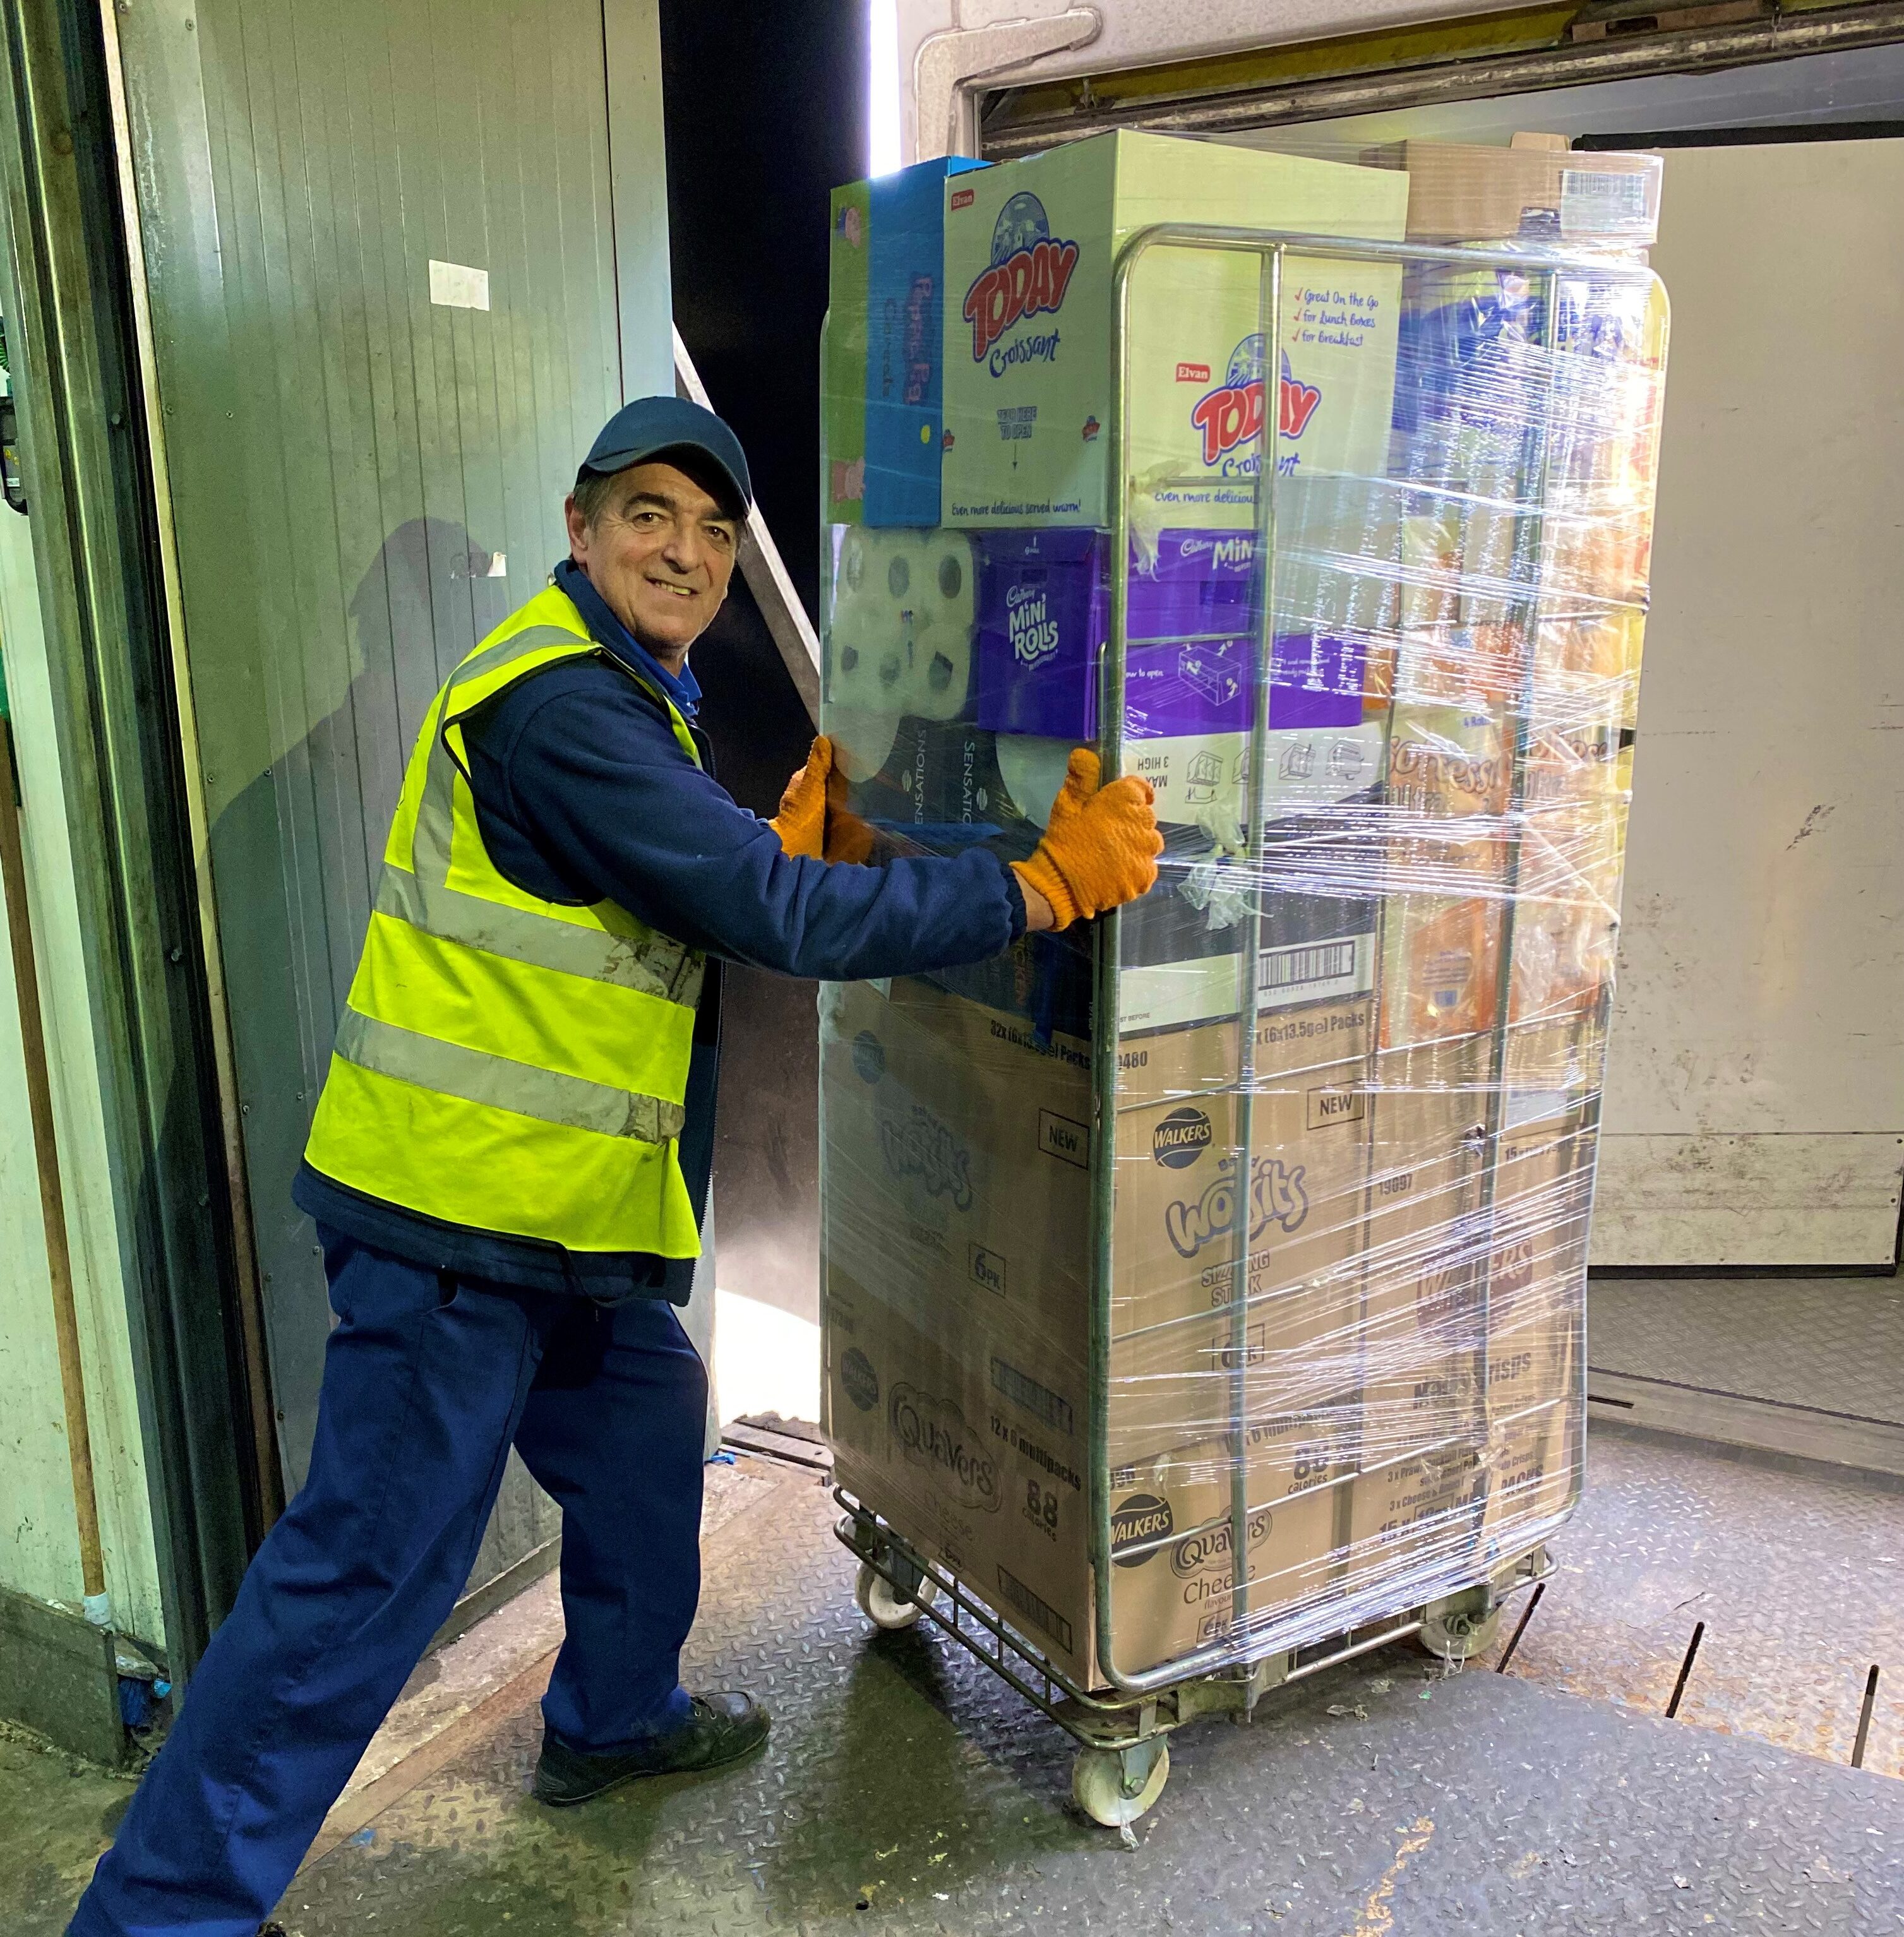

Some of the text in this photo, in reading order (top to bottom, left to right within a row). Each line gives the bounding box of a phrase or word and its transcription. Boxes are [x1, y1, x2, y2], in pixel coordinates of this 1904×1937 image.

[964, 239, 1079, 361] TODAY
[1305, 289, 1379, 311] Great On the Go
[989, 328, 1061, 378] Croissant
[1178, 366, 1209, 380] Elvan
[991, 499, 1023, 515] delicious
[1183, 492, 1210, 503] more
[1214, 488, 1254, 503] deliciou
[1014, 620, 1059, 661] ROLLS
[915, 729, 926, 825] ENSATIONS
[1137, 756, 1170, 771] 3 HIGH
[962, 741, 975, 824] SENSATIO
[1128, 1013, 1151, 1022] BEFORE
[1331, 1013, 1365, 1032] Packs
[1319, 1094, 1353, 1117] NEW
[1049, 1125, 1079, 1153] NEW
[1154, 1122, 1211, 1150] WALKERS
[1166, 1159, 1309, 1260] Wosits
[1201, 1249, 1270, 1287] SIZZNG
[1211, 1274, 1262, 1307] STK
[897, 1403, 995, 1496] Quavers
[1287, 1474, 1328, 1494] calories
[1387, 1471, 1393, 1482] 3
[1027, 1478, 1058, 1529] 88
[1389, 1501, 1395, 1511] 3
[1183, 1564, 1256, 1604] Cheee
